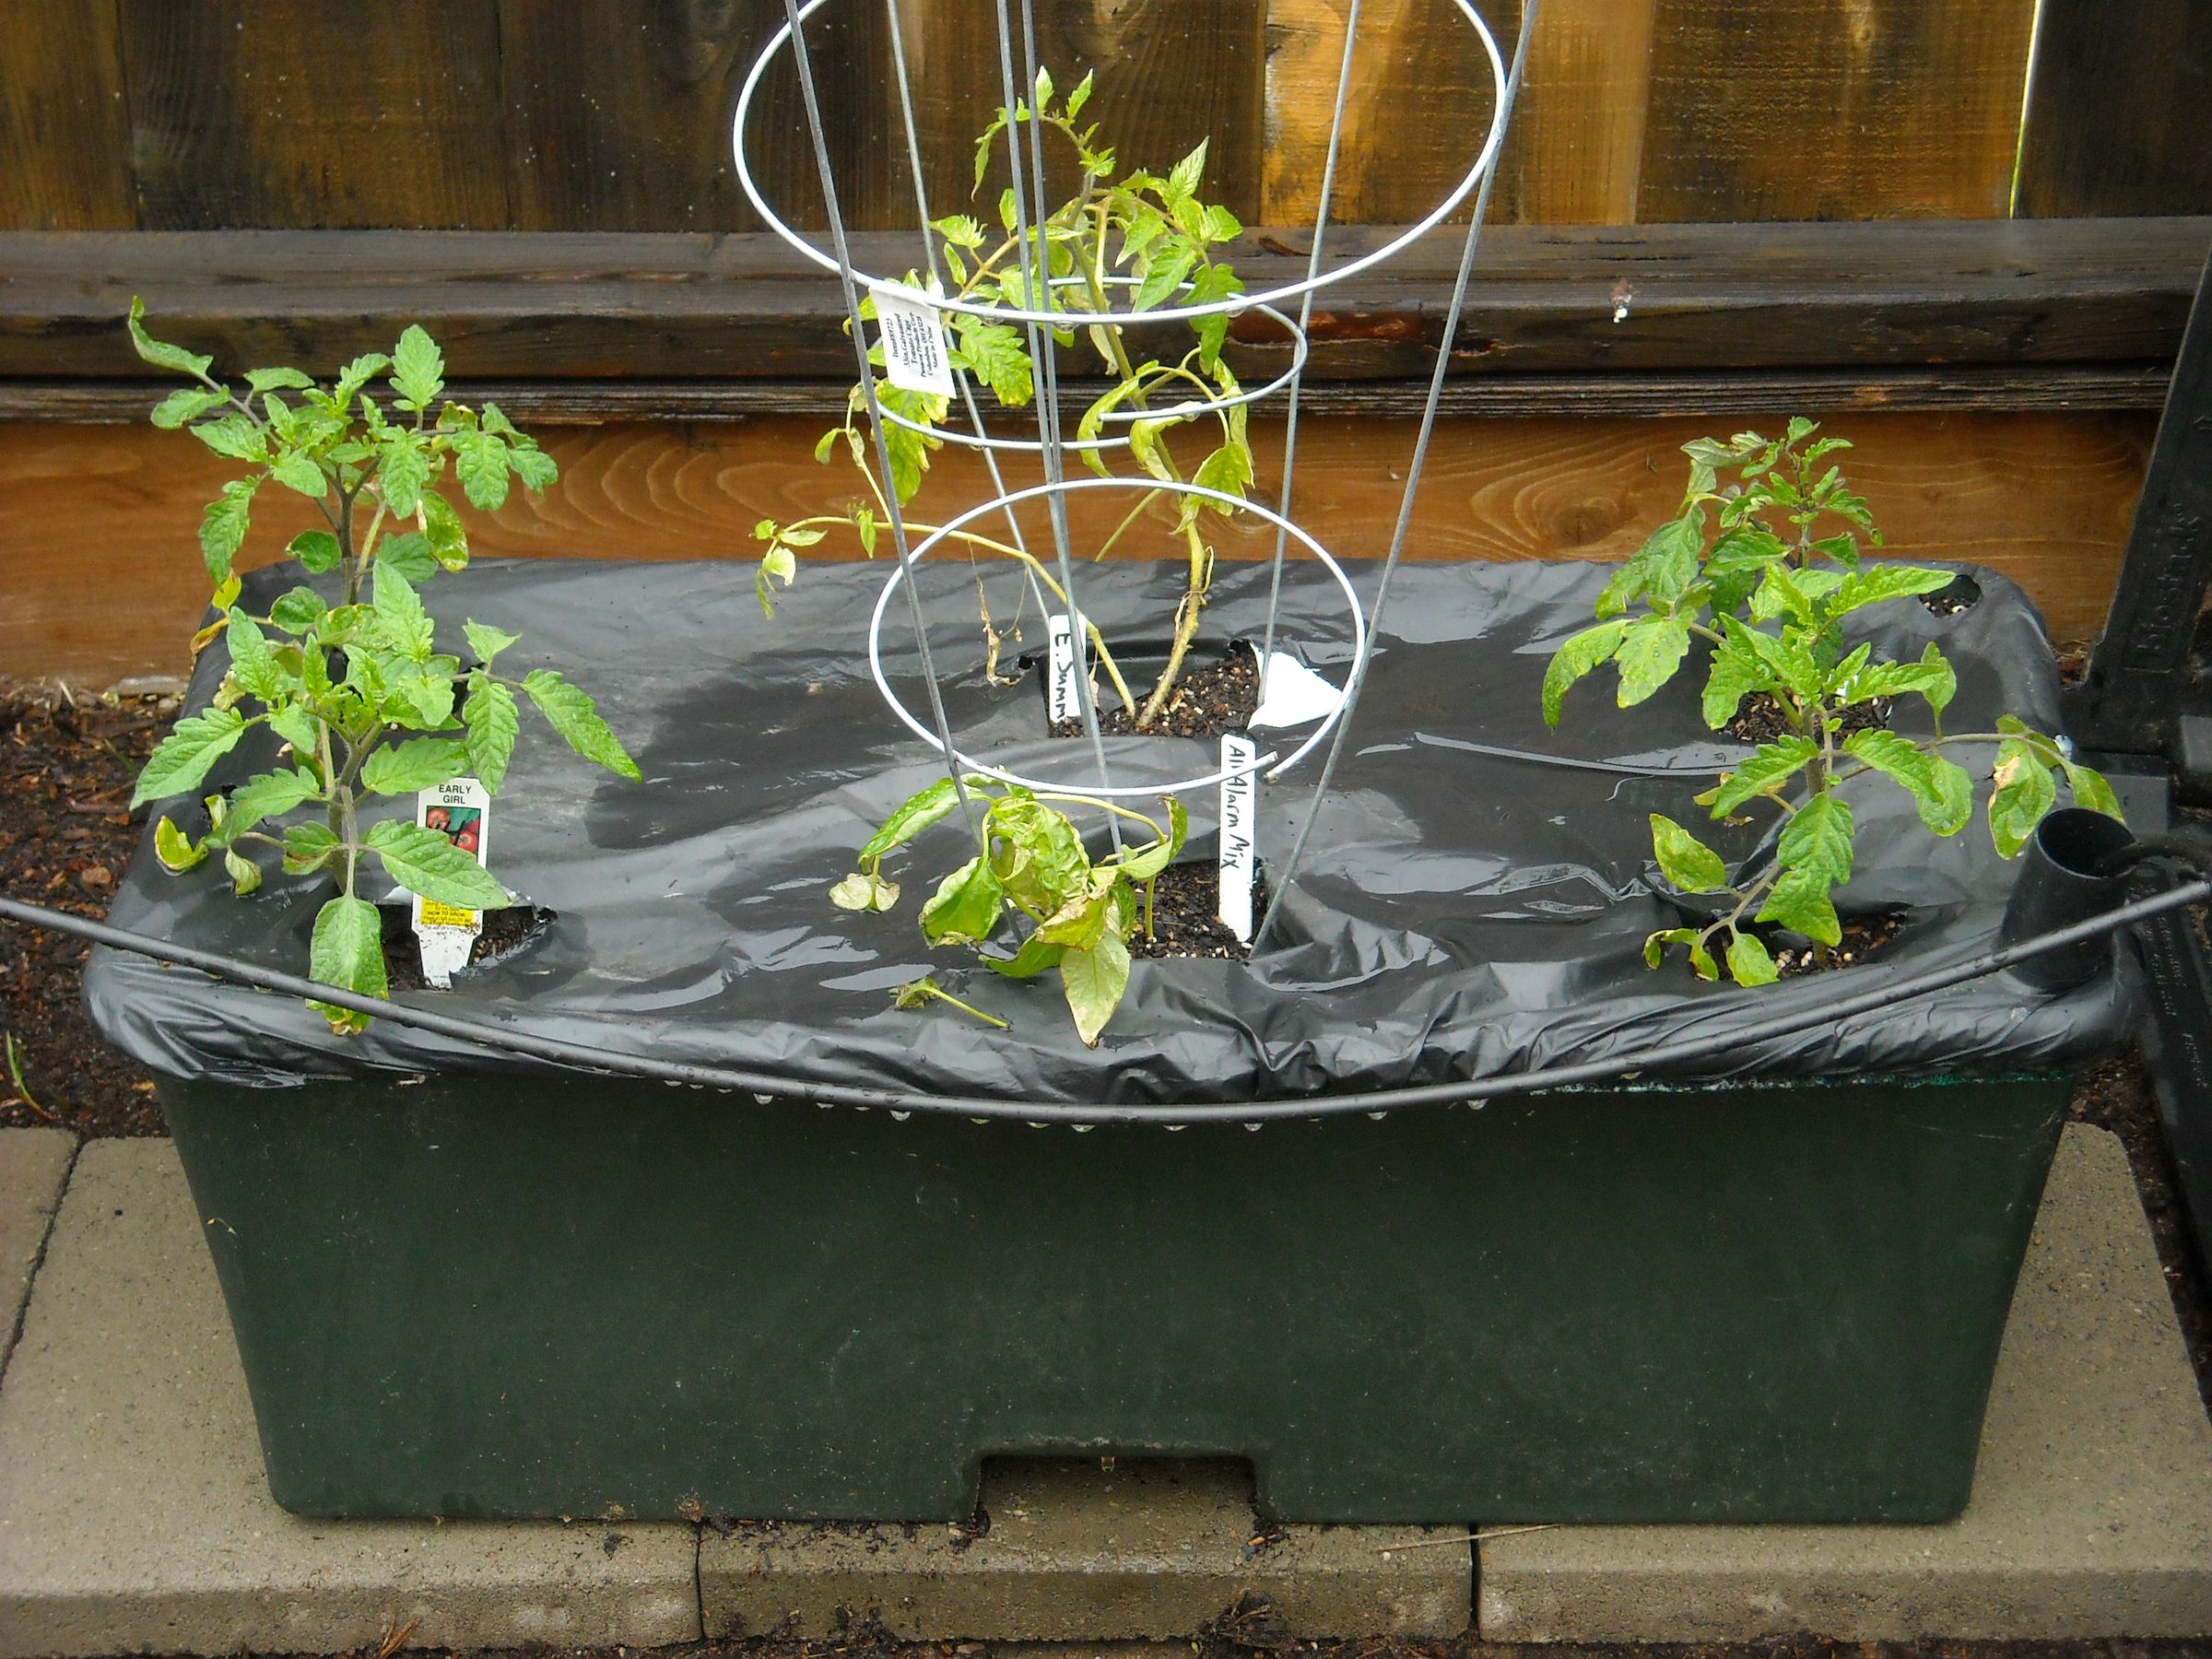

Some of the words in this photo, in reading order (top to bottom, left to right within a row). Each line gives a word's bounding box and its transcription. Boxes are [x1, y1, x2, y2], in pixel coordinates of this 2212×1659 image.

[909, 336, 918, 364] Tomato
[913, 327, 922, 353] Products
[921, 333, 927, 344] OH
[439, 784, 472, 794] EARLY
[442, 794, 466, 805] GIRL
[1226, 775, 1248, 828] Alarm
[1220, 833, 1251, 869] Mix
